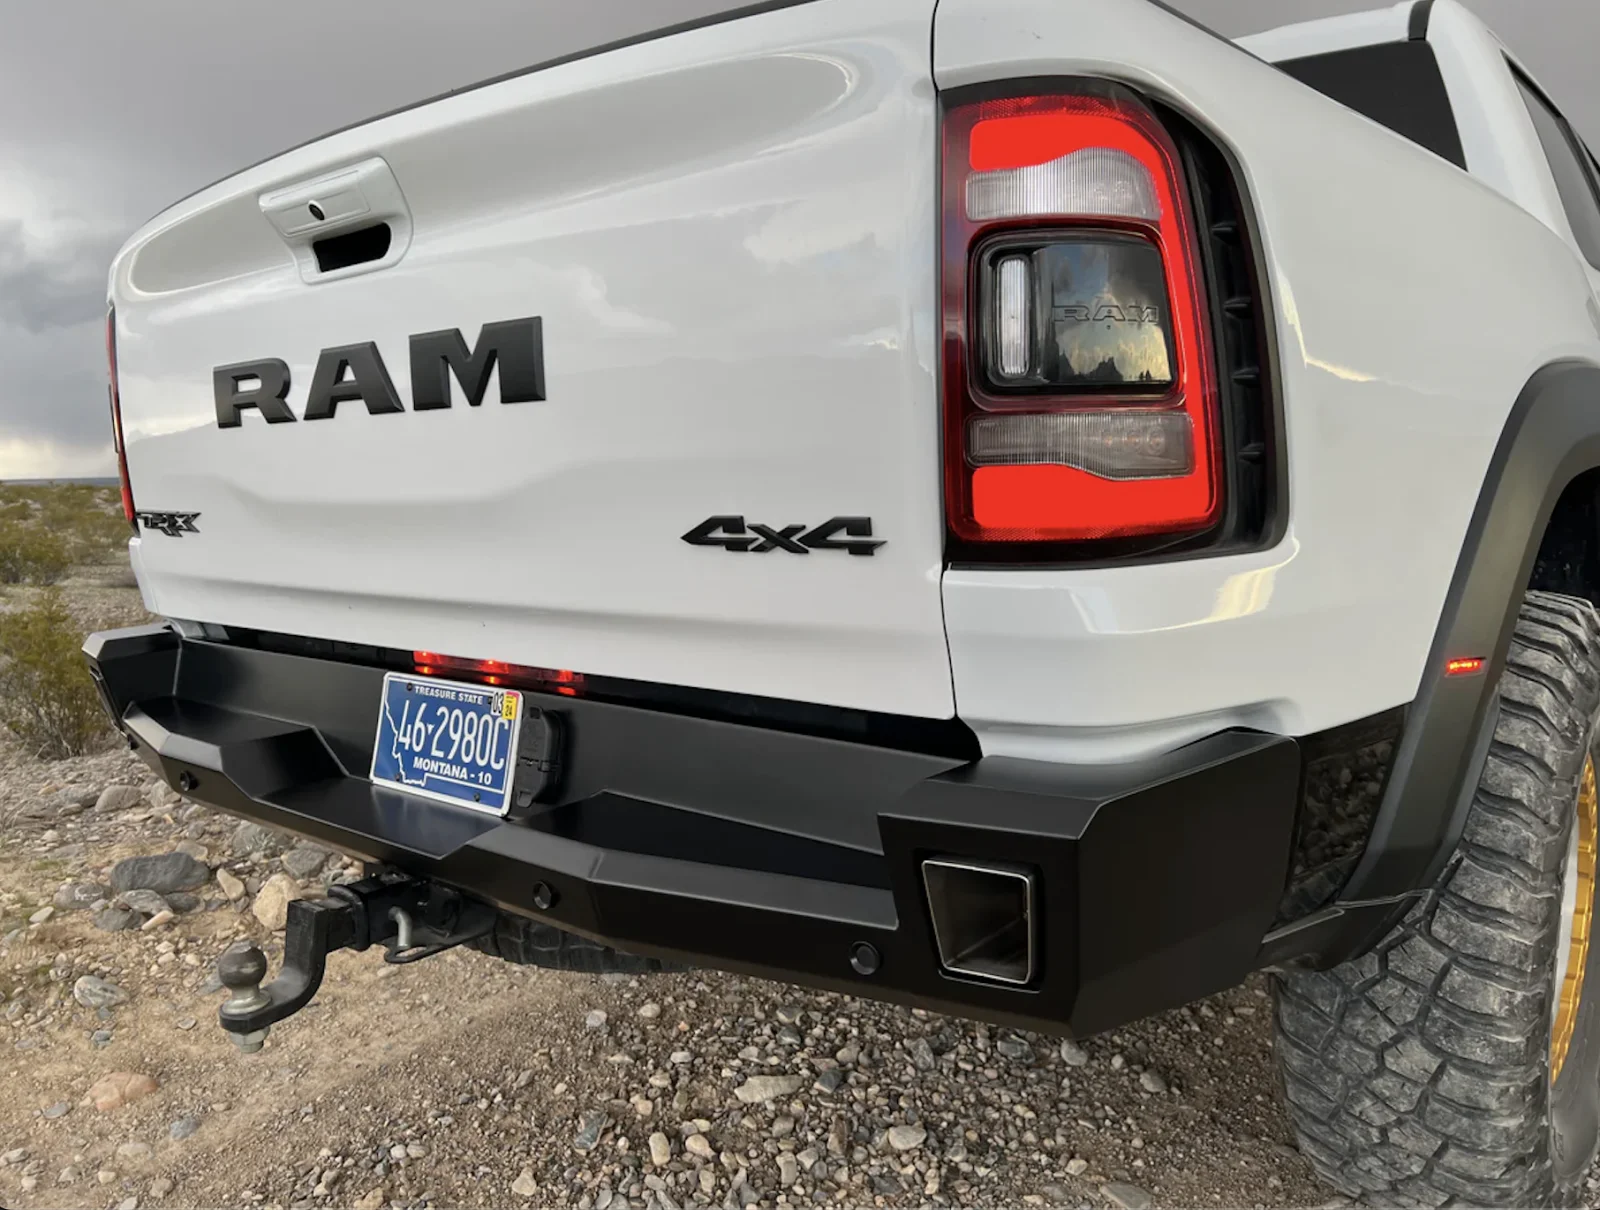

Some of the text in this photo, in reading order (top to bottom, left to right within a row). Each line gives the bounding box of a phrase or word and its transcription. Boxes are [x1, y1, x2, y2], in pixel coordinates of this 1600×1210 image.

[1052, 305, 1159, 322] RAM
[213, 316, 546, 428] RAM
[135, 511, 202, 537] TRX
[414, 685, 483, 705] TREASURE STATE
[413, 756, 468, 780] MONTANA
[478, 771, 492, 785] 10
